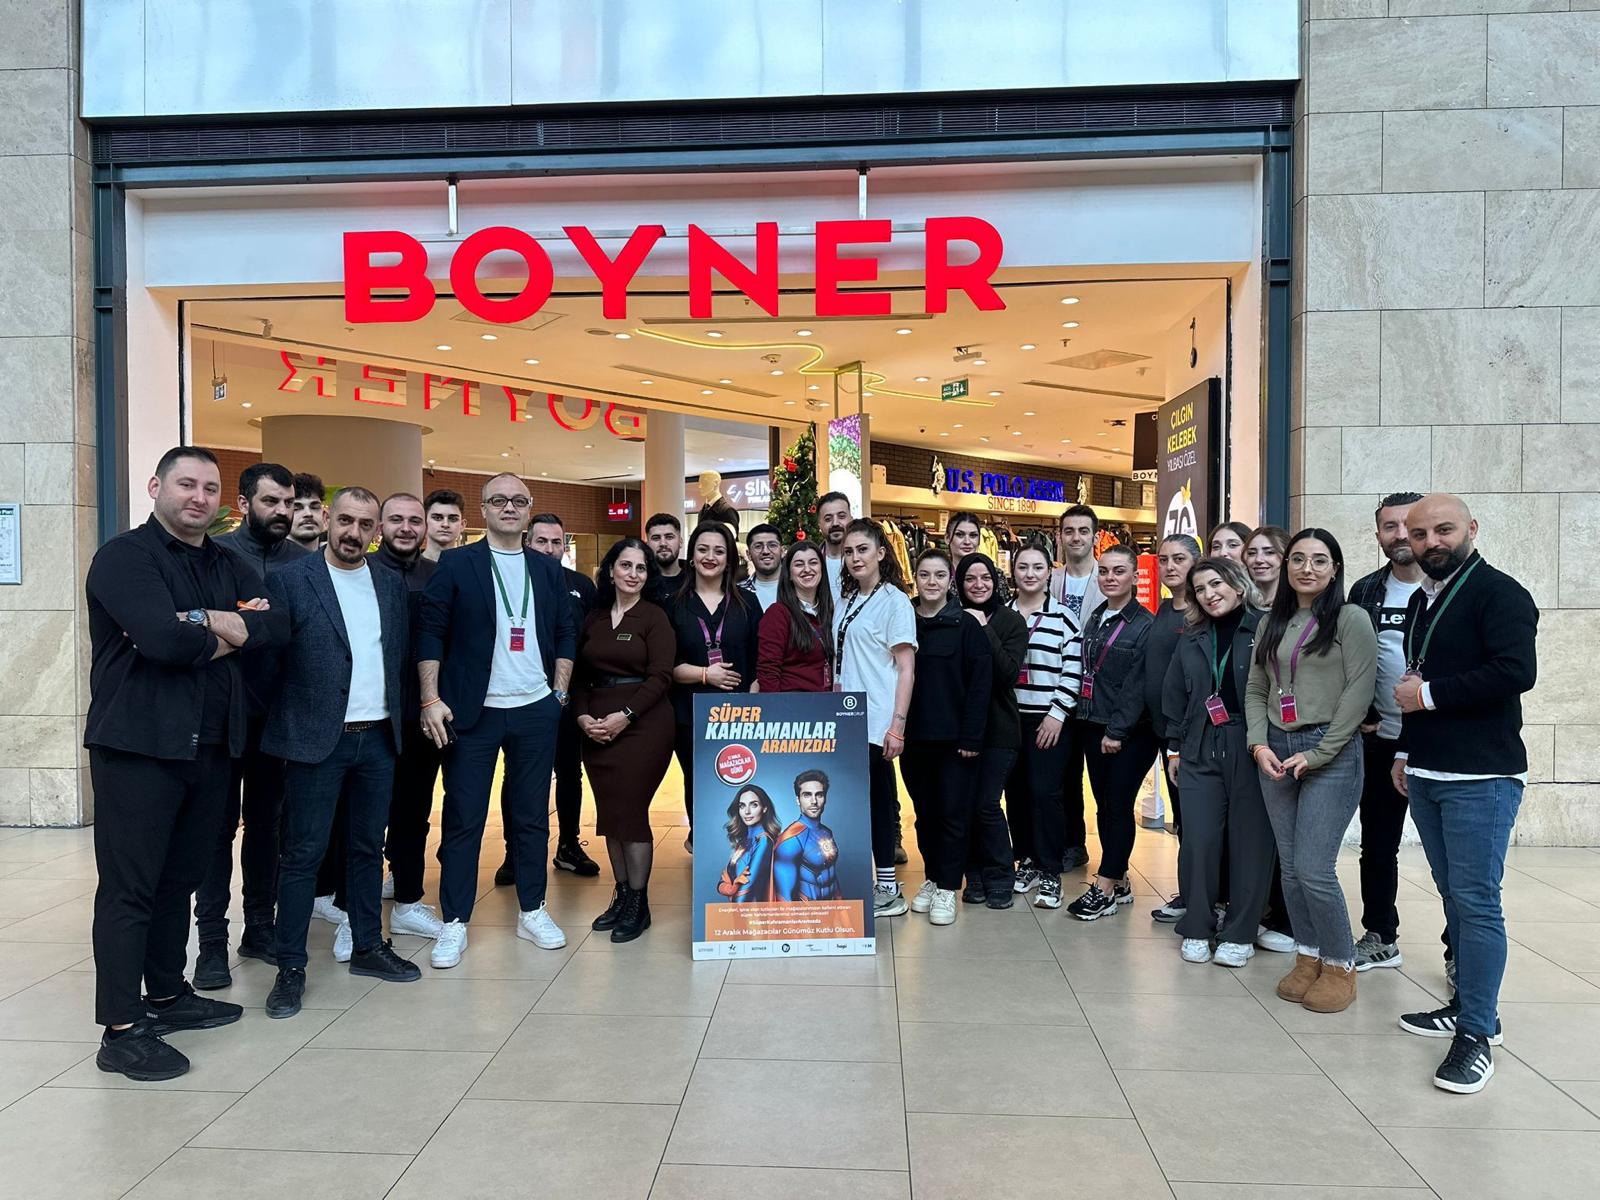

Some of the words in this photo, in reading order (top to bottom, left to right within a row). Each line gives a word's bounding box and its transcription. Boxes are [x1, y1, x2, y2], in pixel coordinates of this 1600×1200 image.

[343, 216, 1006, 323] BOYNER
[1171, 402, 1194, 430] ÇILGIN
[1167, 425, 1197, 454] KELEBEK
[946, 468, 978, 494] U.S.
[981, 473, 1024, 497] POLO
[988, 497, 1014, 511] SINCE
[1017, 500, 1037, 513] 1890
[708, 703, 762, 723] SÜPER
[705, 721, 837, 741] KAHRAMANLAR
[760, 738, 837, 754] ARAMIZDA!
[742, 928, 782, 937] Mağazacılar
